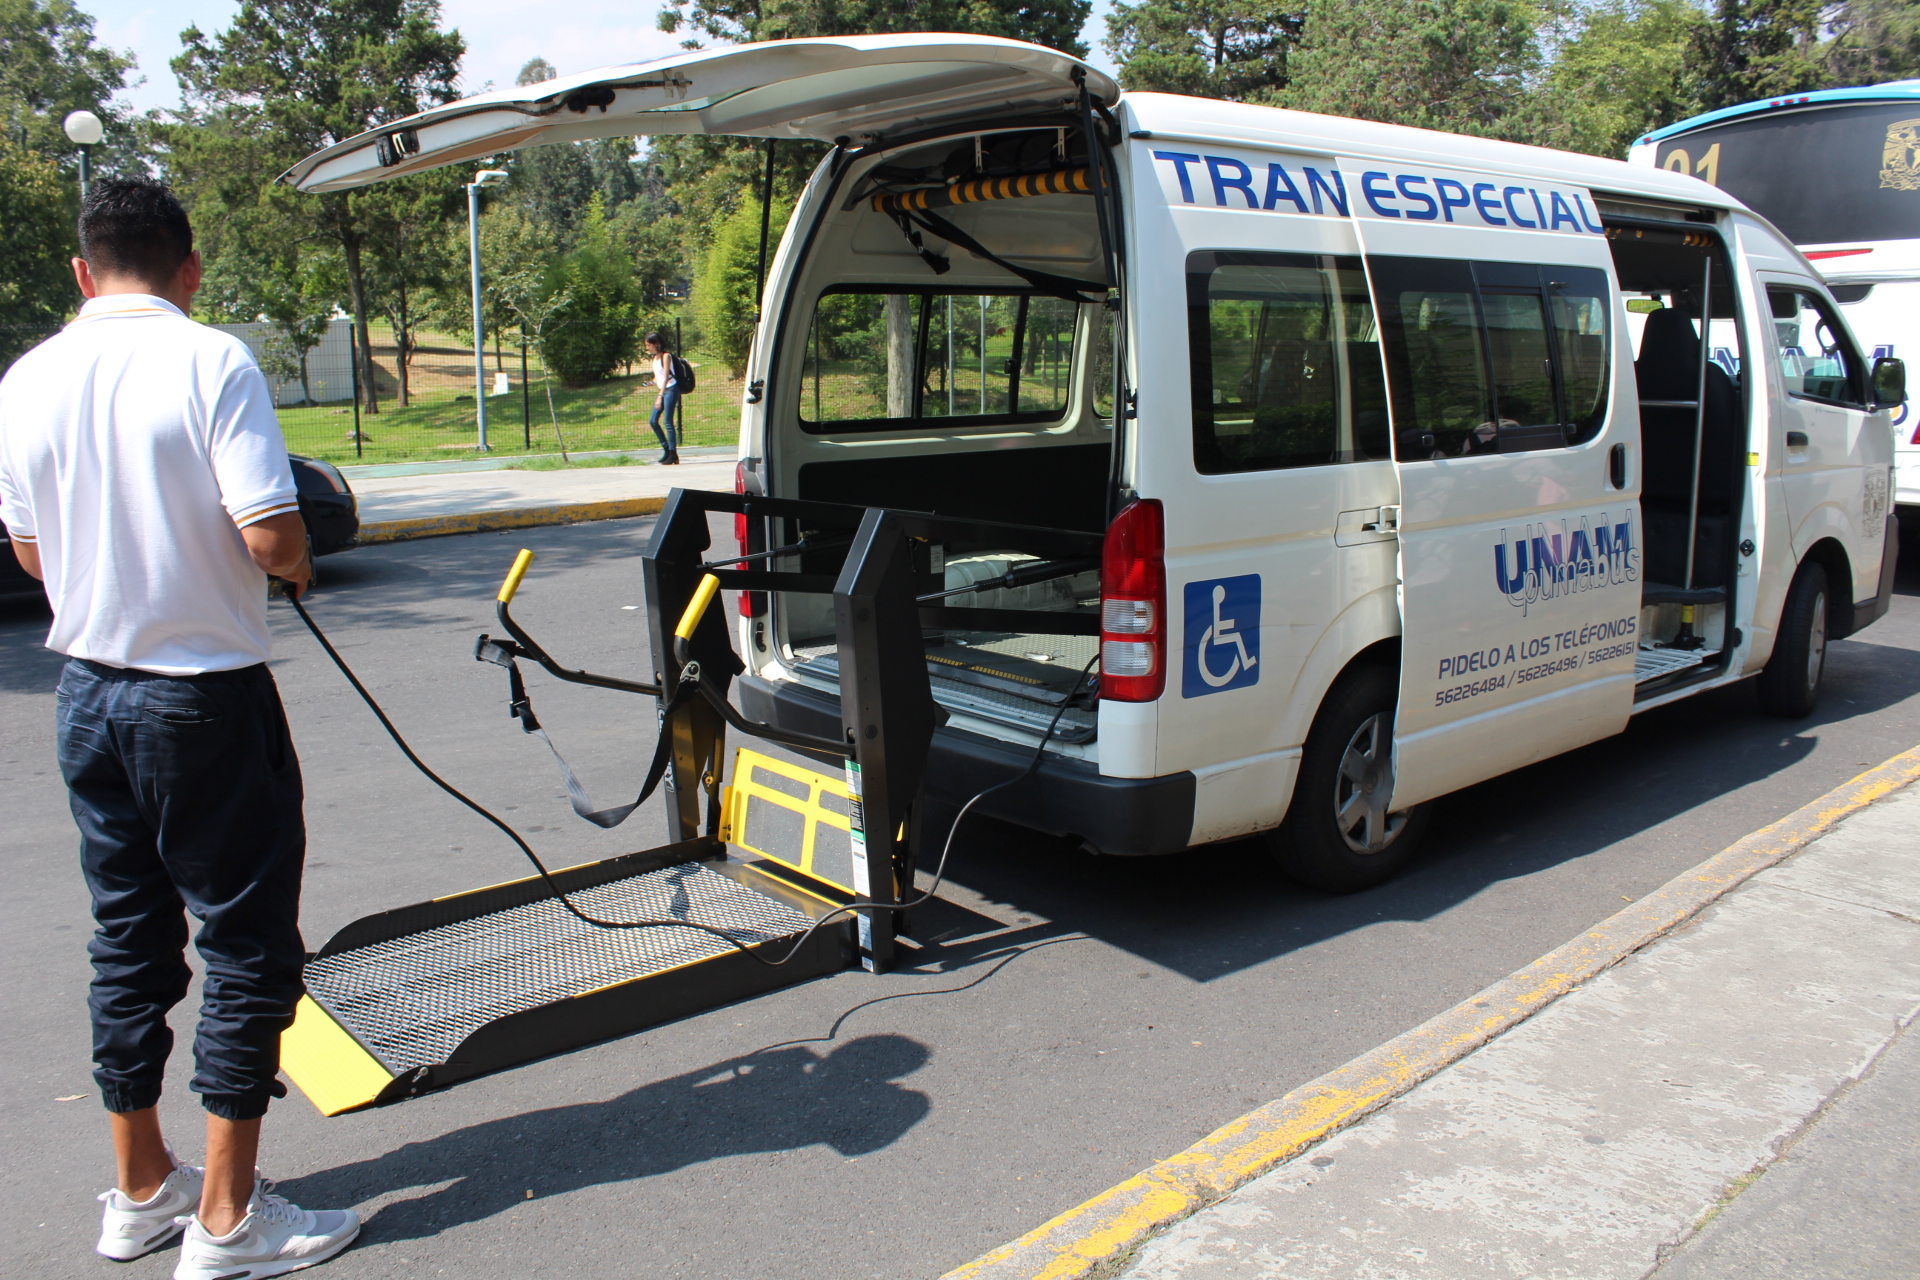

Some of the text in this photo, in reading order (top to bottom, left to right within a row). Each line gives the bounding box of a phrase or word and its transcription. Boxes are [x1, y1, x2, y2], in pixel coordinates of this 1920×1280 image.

[1153, 150, 1604, 234] TRAN ESPECIAL
[1494, 509, 1635, 607] UNAM
[1435, 673, 1506, 707] 56226484
[1517, 660, 1578, 685] 56226496
[1588, 641, 1635, 665] 56226151
[1438, 616, 1637, 680] PIDELO A LOS TELÉFONOS
